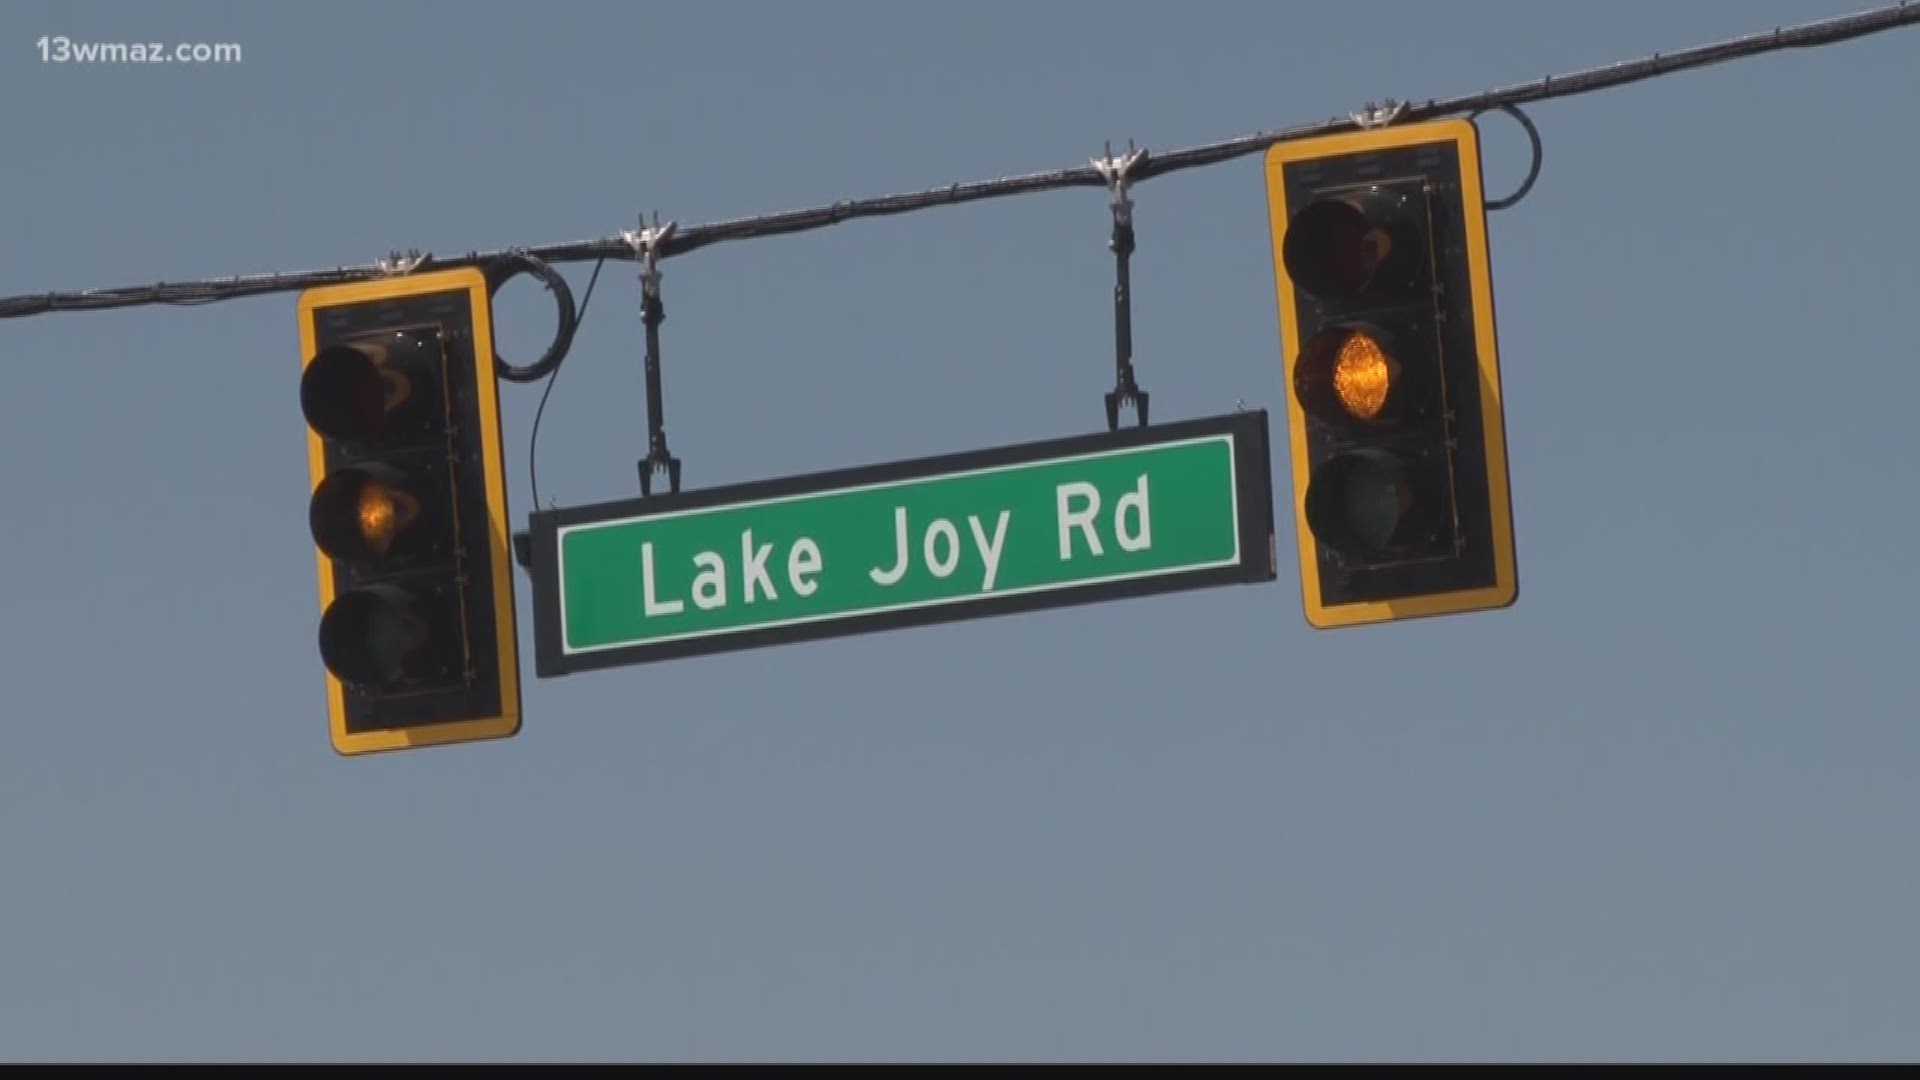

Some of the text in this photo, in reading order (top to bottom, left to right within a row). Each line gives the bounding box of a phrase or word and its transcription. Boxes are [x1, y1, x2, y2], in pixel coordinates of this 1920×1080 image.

[641, 473, 1153, 617] Lake Joy Rd
